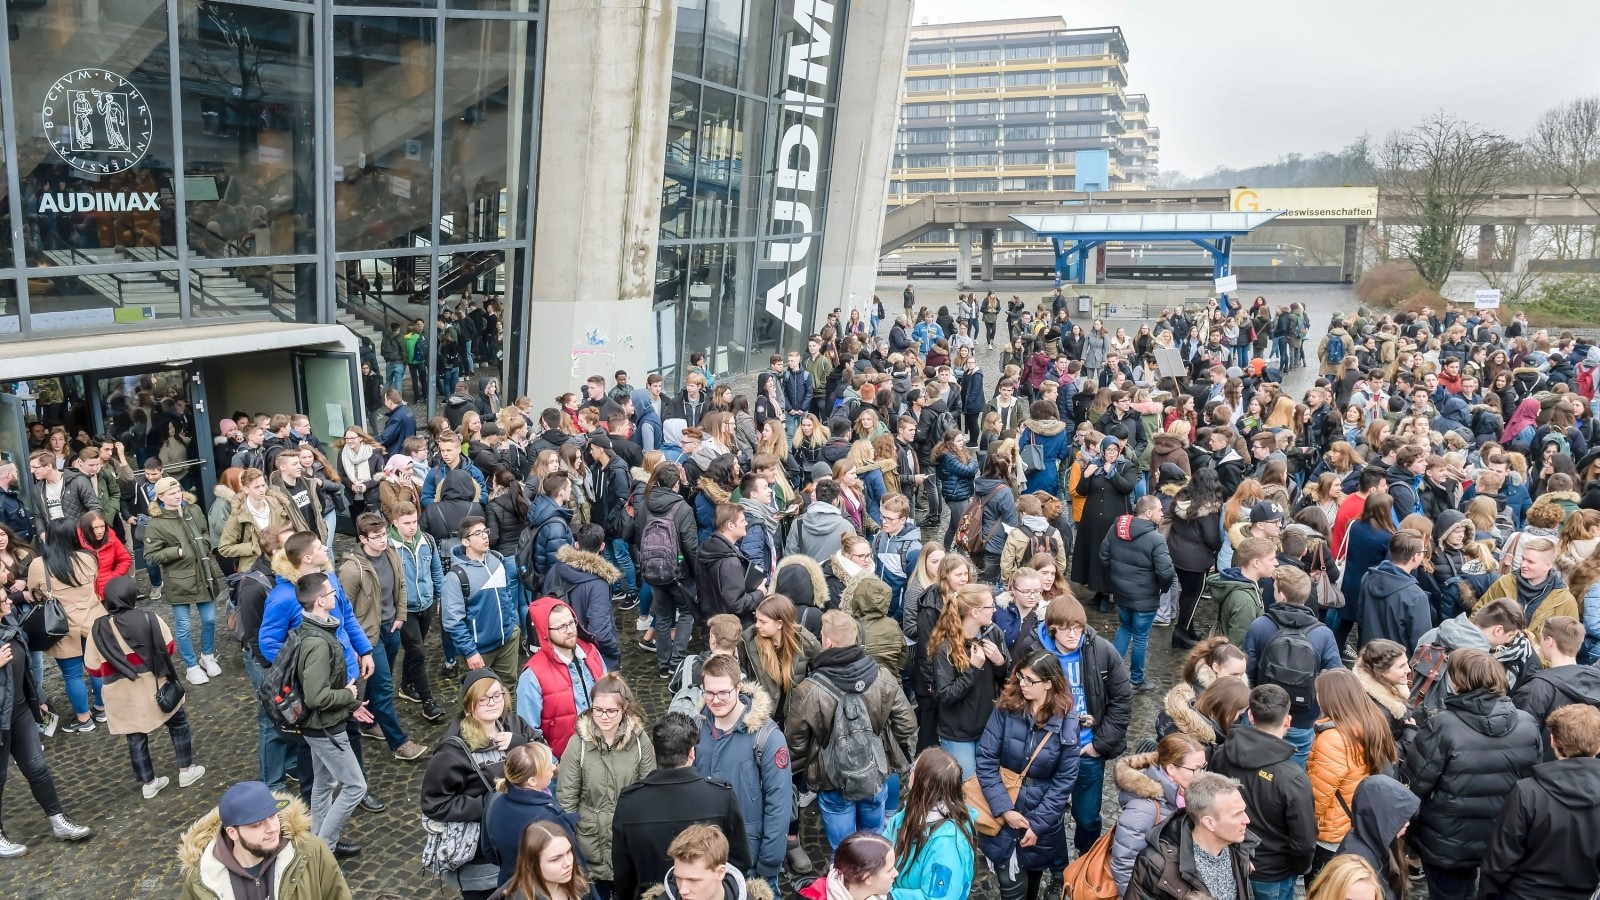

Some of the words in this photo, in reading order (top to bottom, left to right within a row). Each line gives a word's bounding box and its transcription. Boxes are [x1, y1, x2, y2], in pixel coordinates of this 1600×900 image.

[38, 192, 161, 213] AUDIMAX
[1265, 207, 1372, 216] teswissenschaften
[1119, 517, 1129, 540] HILFI
